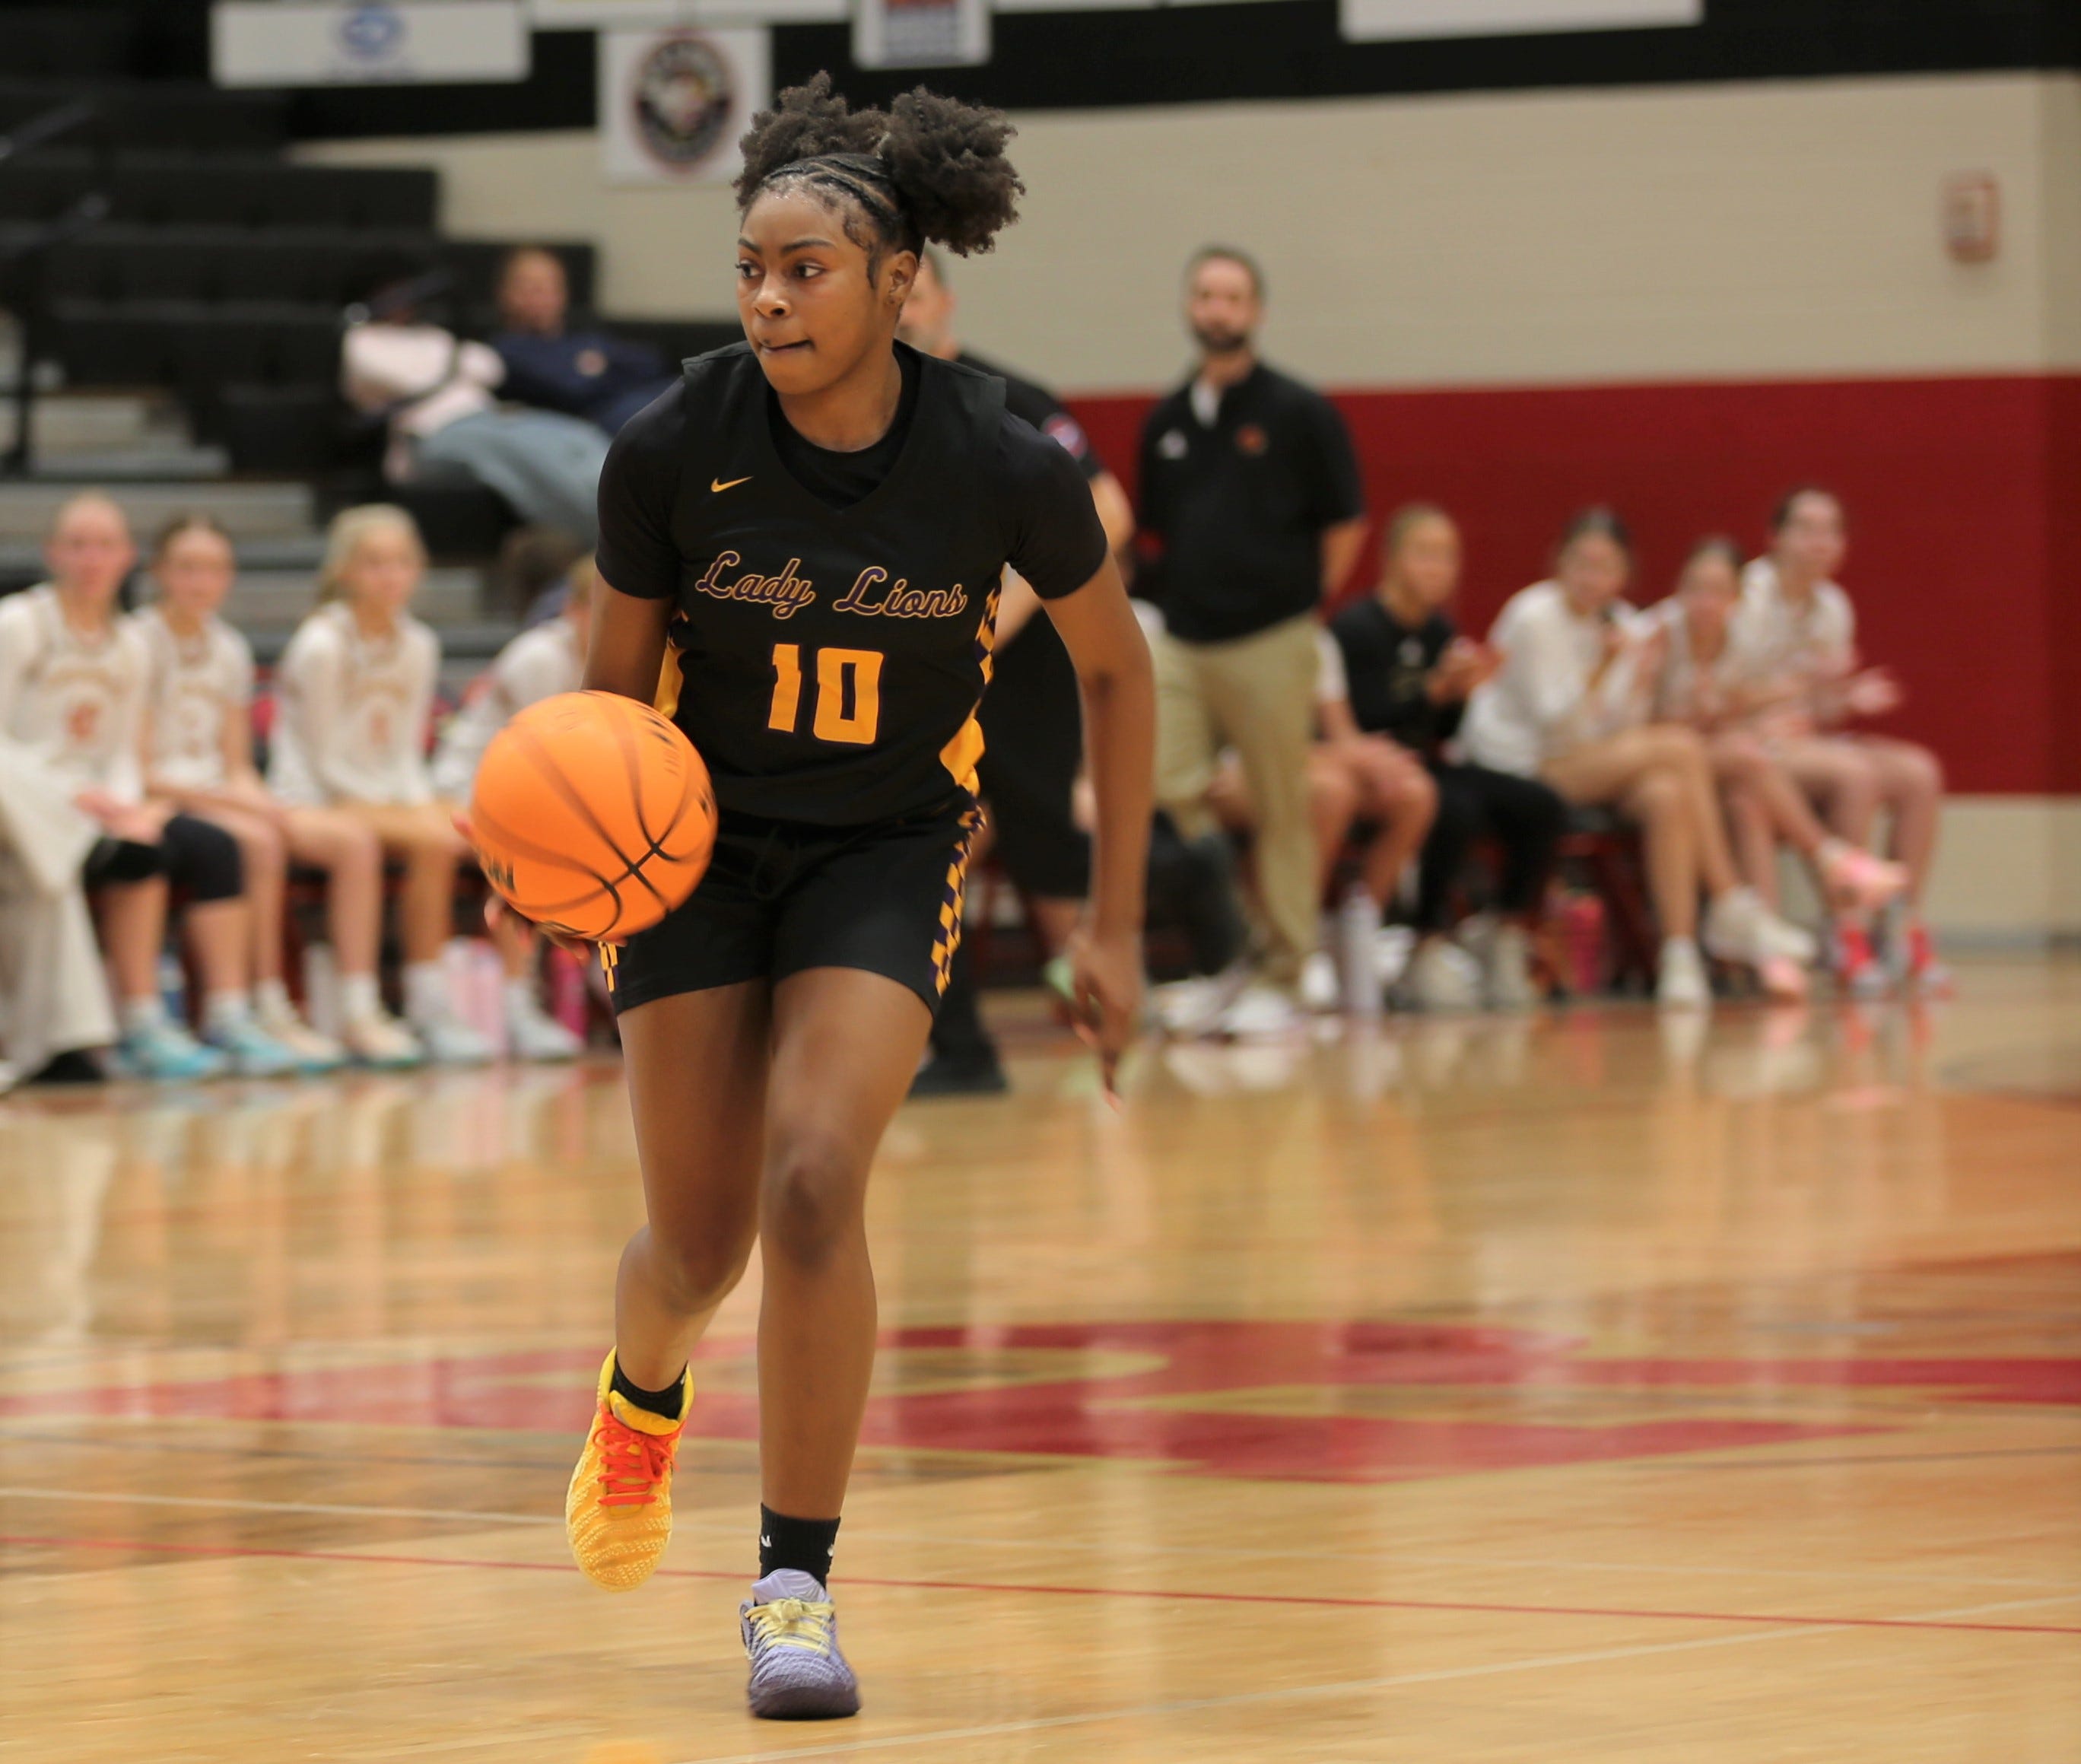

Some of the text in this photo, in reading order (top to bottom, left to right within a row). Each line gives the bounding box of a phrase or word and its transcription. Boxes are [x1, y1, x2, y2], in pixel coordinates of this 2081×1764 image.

[695, 551, 967, 620] Lady Lions
[768, 644, 885, 745] 10
